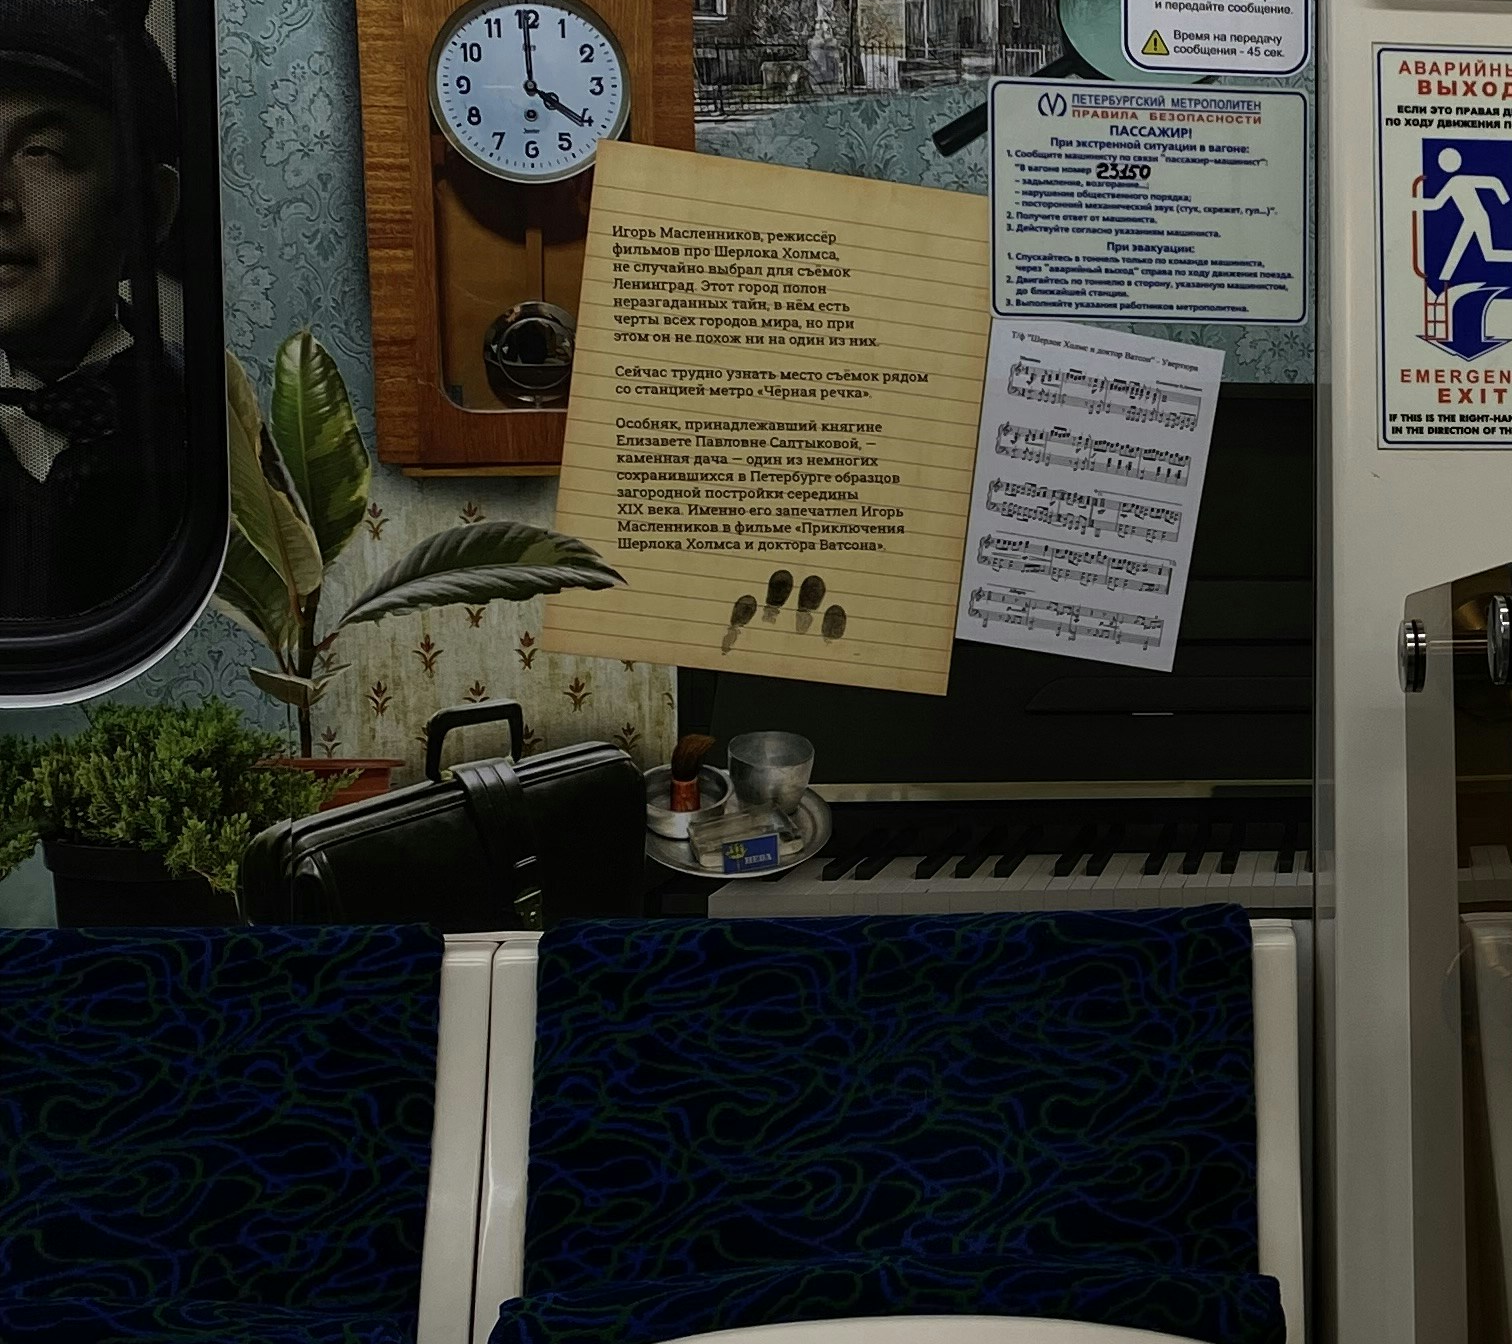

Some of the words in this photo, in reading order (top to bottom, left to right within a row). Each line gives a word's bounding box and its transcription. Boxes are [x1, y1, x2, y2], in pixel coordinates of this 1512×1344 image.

[1071, 92, 1165, 109] ПЕТЕРБУРГСКИЙ
[1171, 97, 1262, 111] МЕТРОПОЛИТЕН
[1072, 110, 1139, 120] ПРАВИЛА
[1149, 112, 1262, 125] БЕЗОПАСНОСТИ
[1397, 105, 1428, 115] ЕСЛИ
[1431, 106, 1453, 116] ЭТО
[1456, 108, 1500, 117] ПРАВАЯ
[1109, 125, 1193, 140] ПАССАЖИР!
[612, 225, 656, 241] Игорь
[660, 226, 764, 243] Масленников,
[766, 231, 837, 246] режиссёр
[1438, 389, 1508, 404] EXIT
